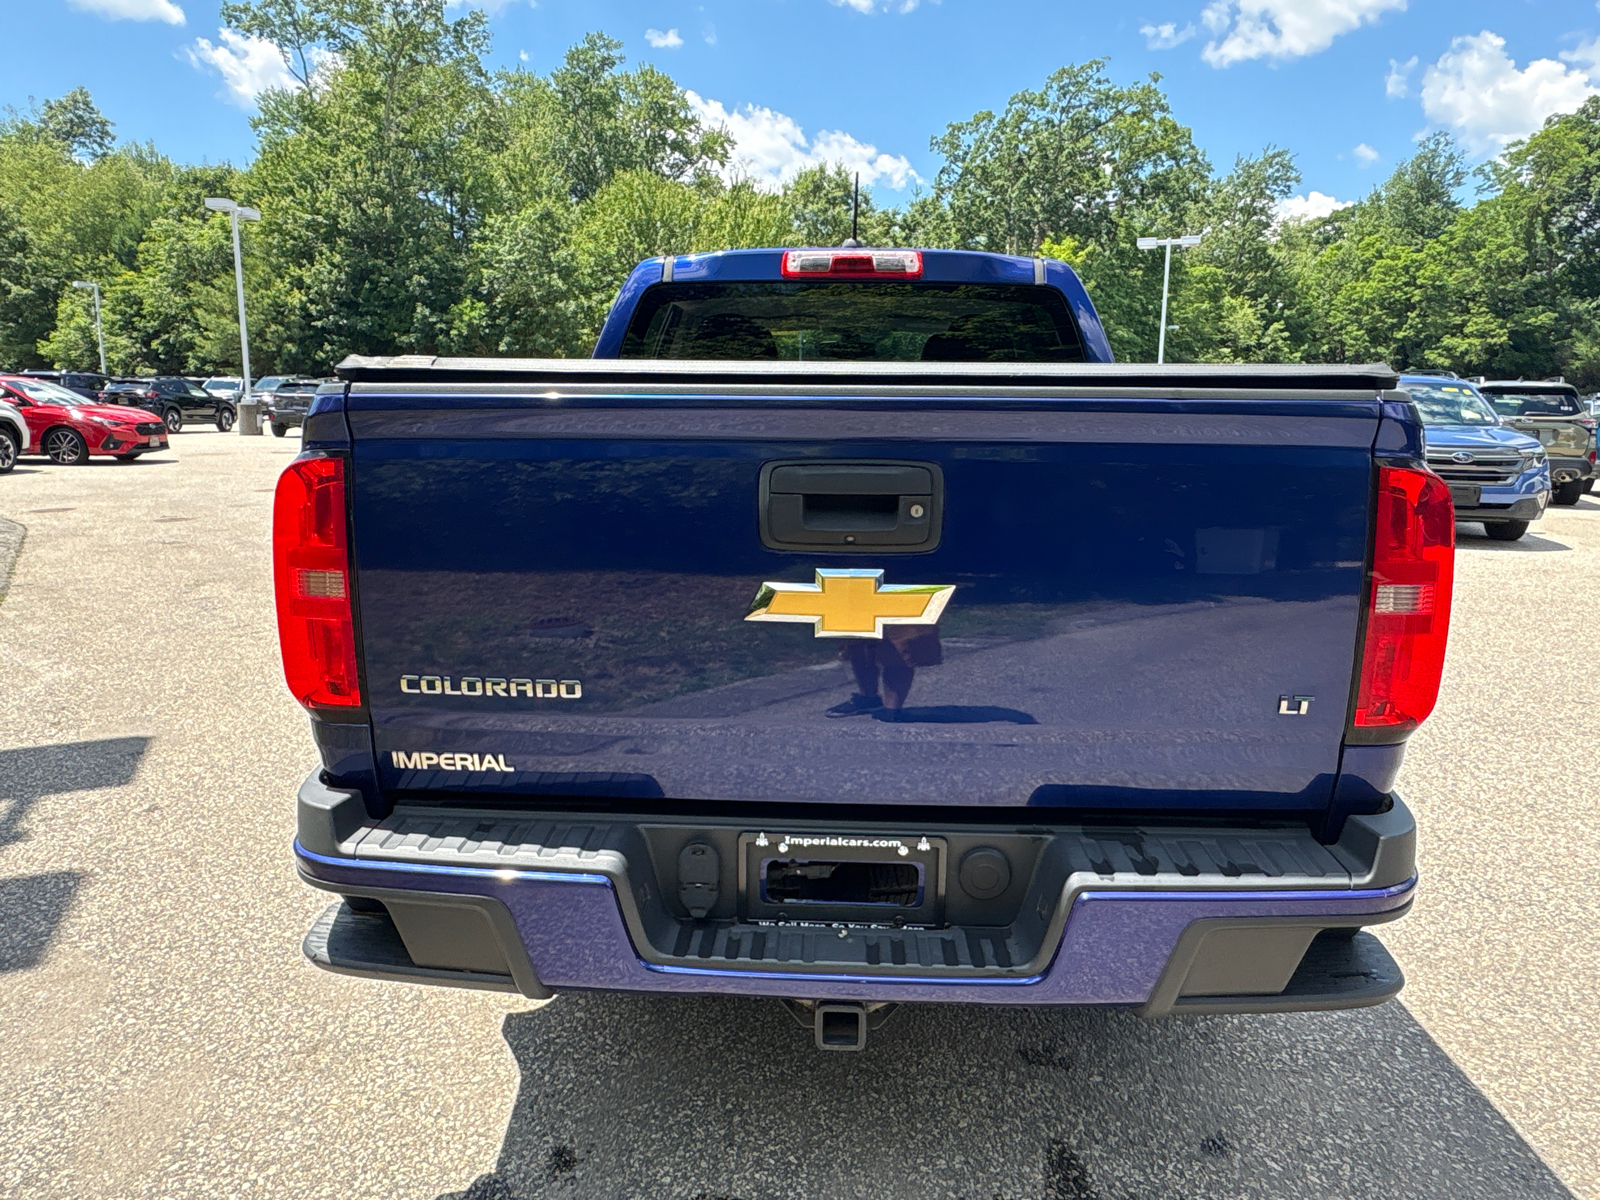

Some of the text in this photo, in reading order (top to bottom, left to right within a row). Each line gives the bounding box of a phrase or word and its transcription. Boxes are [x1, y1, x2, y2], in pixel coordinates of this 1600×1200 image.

[400, 674, 583, 699] COLORADO
[1278, 694, 1316, 715] LT
[391, 750, 515, 772] IMPERIAL
[784, 835, 902, 848] Imperialcars.com
